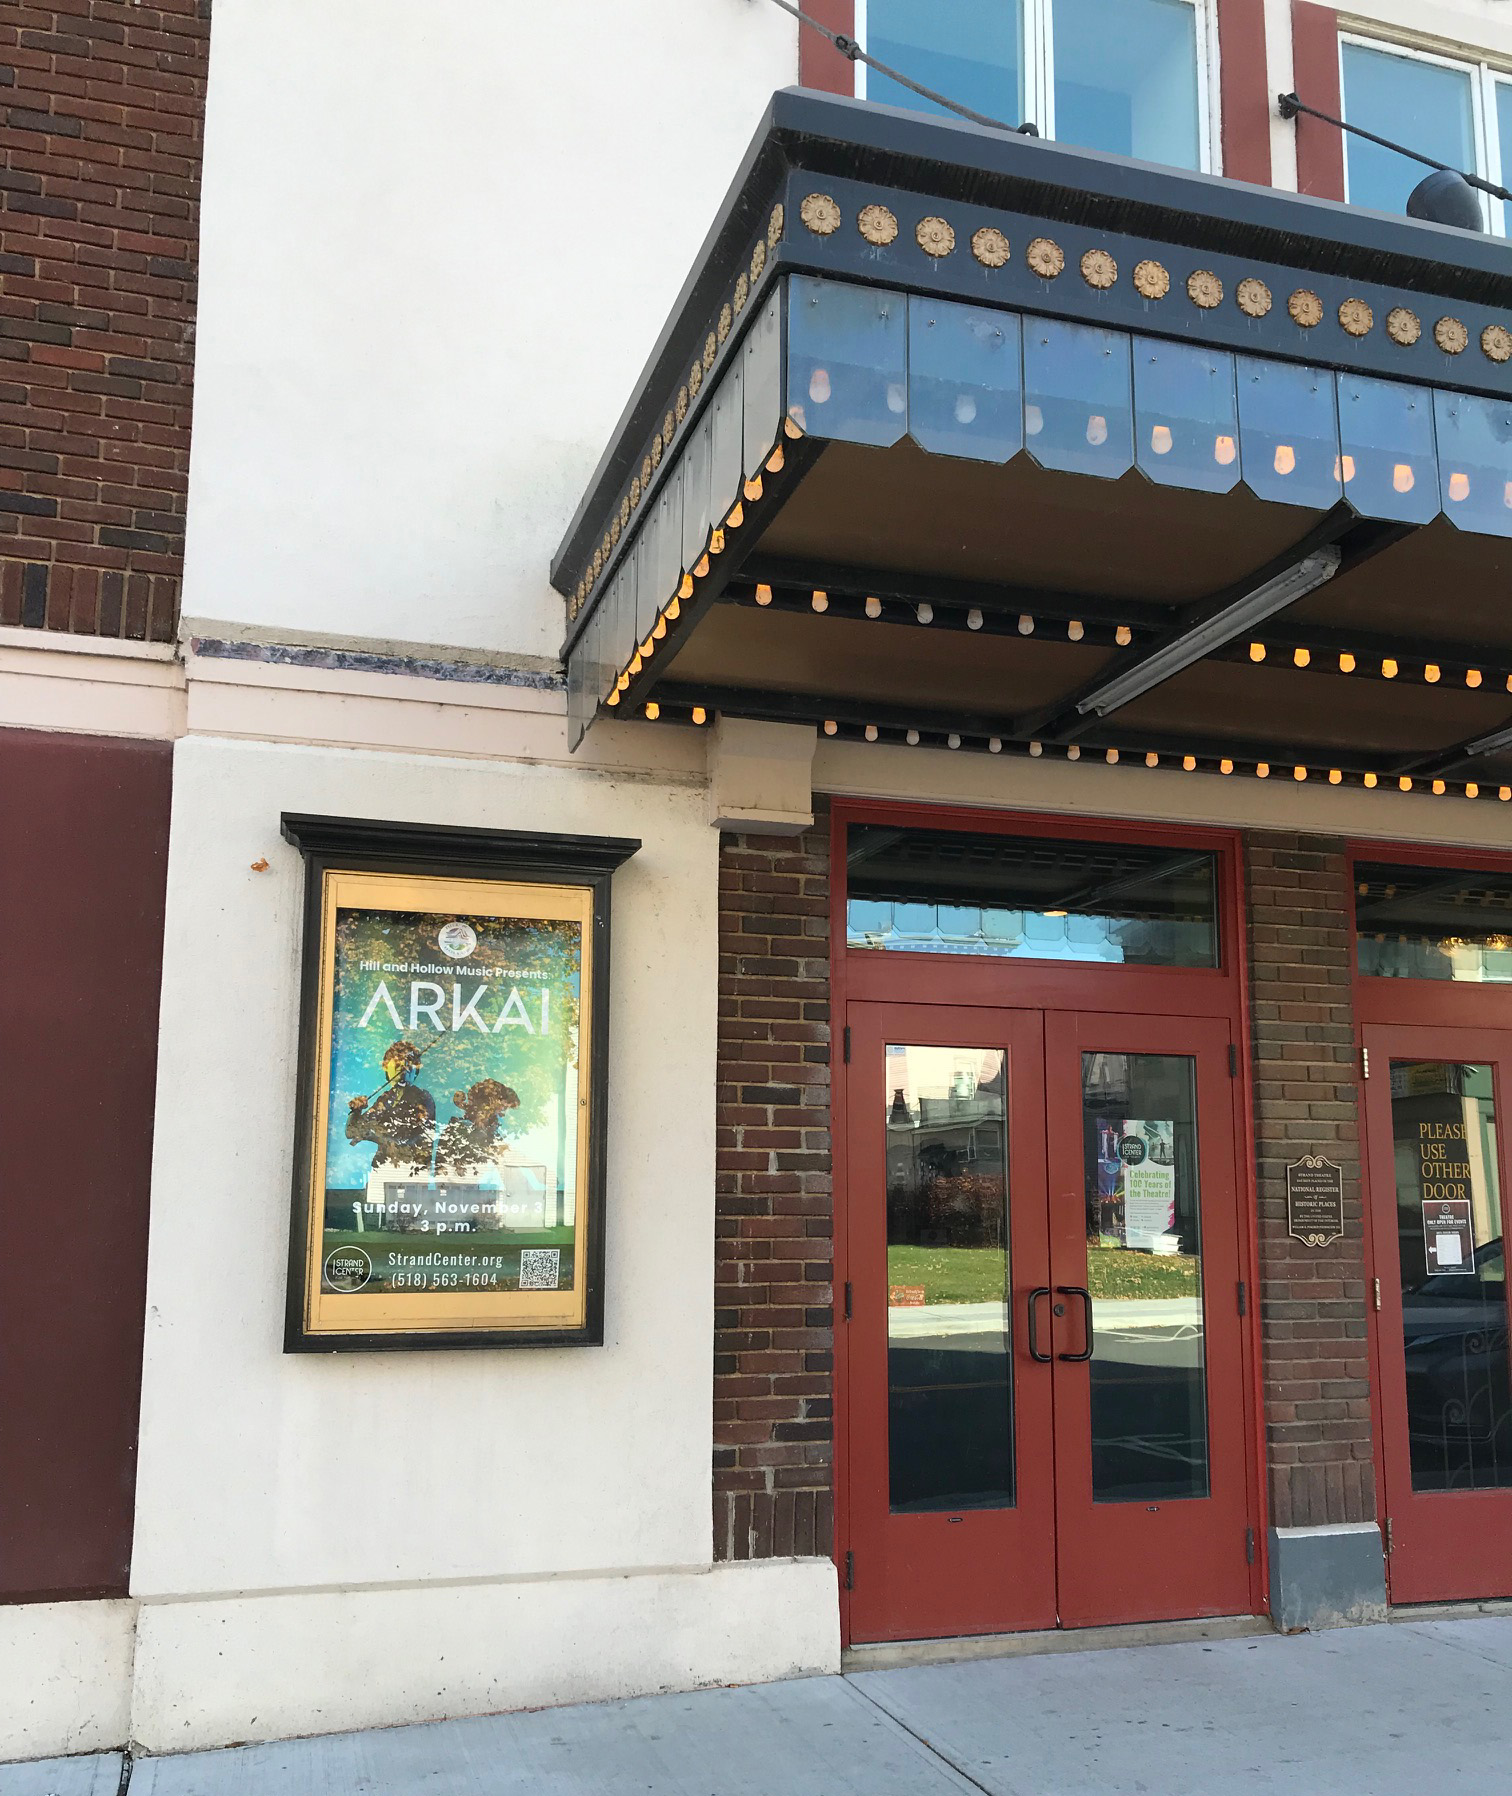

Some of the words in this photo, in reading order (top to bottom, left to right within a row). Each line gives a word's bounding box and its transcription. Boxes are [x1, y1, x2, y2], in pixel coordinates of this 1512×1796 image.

[360, 960, 380, 971] Hill
[382, 962, 408, 973] and
[410, 962, 454, 975] Hollow
[456, 966, 493, 977] Music
[495, 967, 551, 980] Presents:
[357, 979, 550, 1035] ARKAI
[1420, 1143, 1447, 1160] USE
[1129, 1170, 1170, 1181] Celebrating
[1421, 1162, 1471, 1179] OTHER
[1144, 1180, 1163, 1189] Years
[1164, 1181, 1172, 1189] of
[1423, 1182, 1466, 1199] DOOR
[1129, 1190, 1141, 1198] the
[1142, 1190, 1171, 1199] Theatre!
[352, 1201, 429, 1216] Sunday,
[435, 1201, 528, 1214] November
[534, 1201, 544, 1213] 3
[420, 1220, 429, 1232] 3
[436, 1221, 477, 1235] p.m.
[336, 1259, 364, 1267] STRAND
[388, 1252, 503, 1268] StrandCenter.org
[392, 1273, 427, 1289] (518)
[432, 1272, 498, 1287] 563-1604
